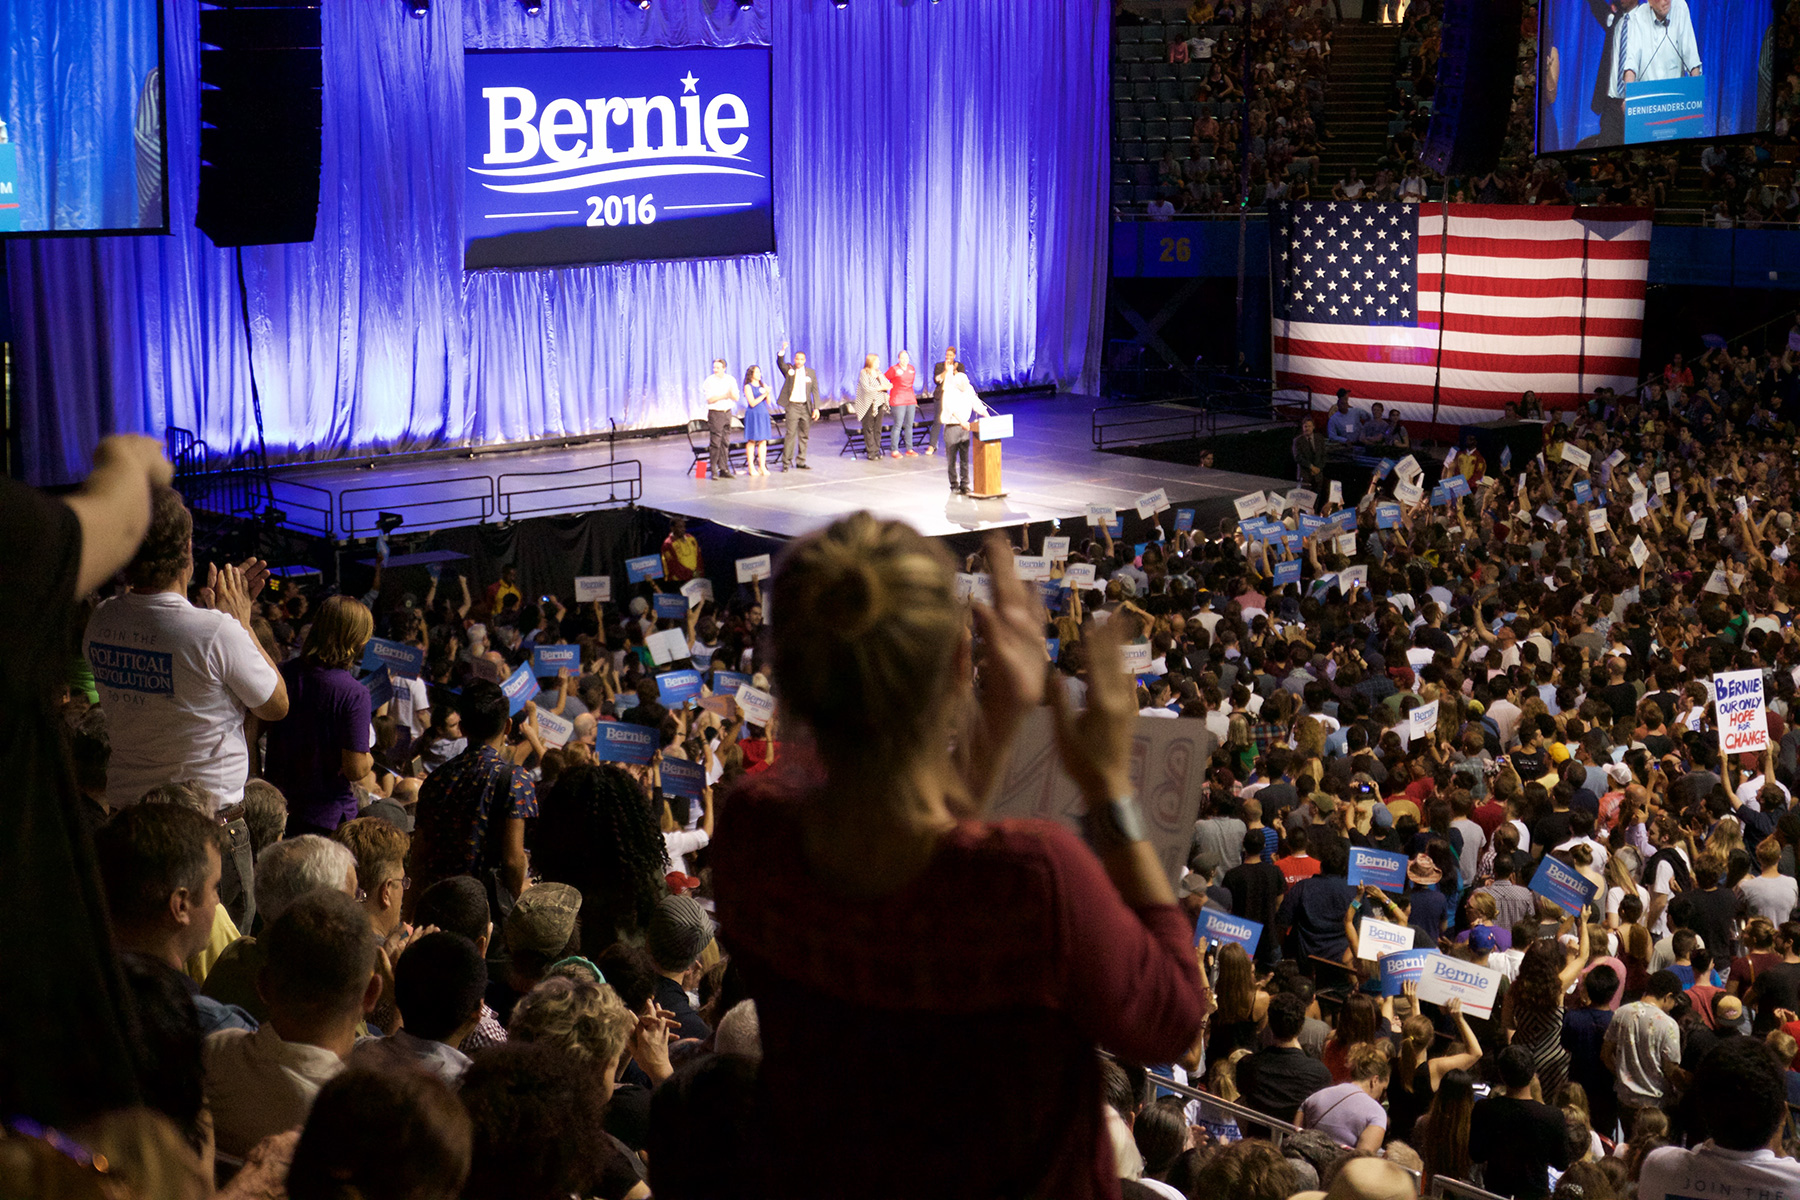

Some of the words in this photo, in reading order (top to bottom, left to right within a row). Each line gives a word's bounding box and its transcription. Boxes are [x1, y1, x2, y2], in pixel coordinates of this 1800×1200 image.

[482, 70, 749, 164] Bernie
[1627, 100, 1703, 116] BERNIESANDERS.COM
[586, 193, 656, 227] 2016
[1160, 237, 1191, 262] 26
[631, 559, 657, 571] Bernie
[1019, 560, 1046, 568] Bernie
[90, 646, 169, 675] POLITICAL
[373, 643, 415, 663] Bernie
[540, 649, 574, 660] Bernie
[504, 670, 530, 697] Bernie
[664, 674, 699, 688] Bernie
[1715, 678, 1762, 701] BERNIE:
[743, 690, 773, 710] Bernie
[1720, 700, 1738, 715] OUR
[1739, 697, 1762, 710] ONLY
[537, 712, 566, 734] Bernie
[1729, 710, 1755, 726] HOPE
[1737, 721, 1751, 731] FOR
[606, 727, 651, 745] Bernie
[1725, 730, 1766, 749] CHANGE
[661, 761, 701, 779] Bernie
[1355, 853, 1399, 871] Bernie
[1546, 863, 1589, 896] Bernie
[1206, 915, 1252, 940] Bernie
[1368, 925, 1407, 946] Bernie
[1386, 954, 1426, 973] Berni
[1434, 961, 1489, 990] Bernie
[1450, 985, 1465, 994] 2016
[1683, 1178, 1731, 1196] JOIN
